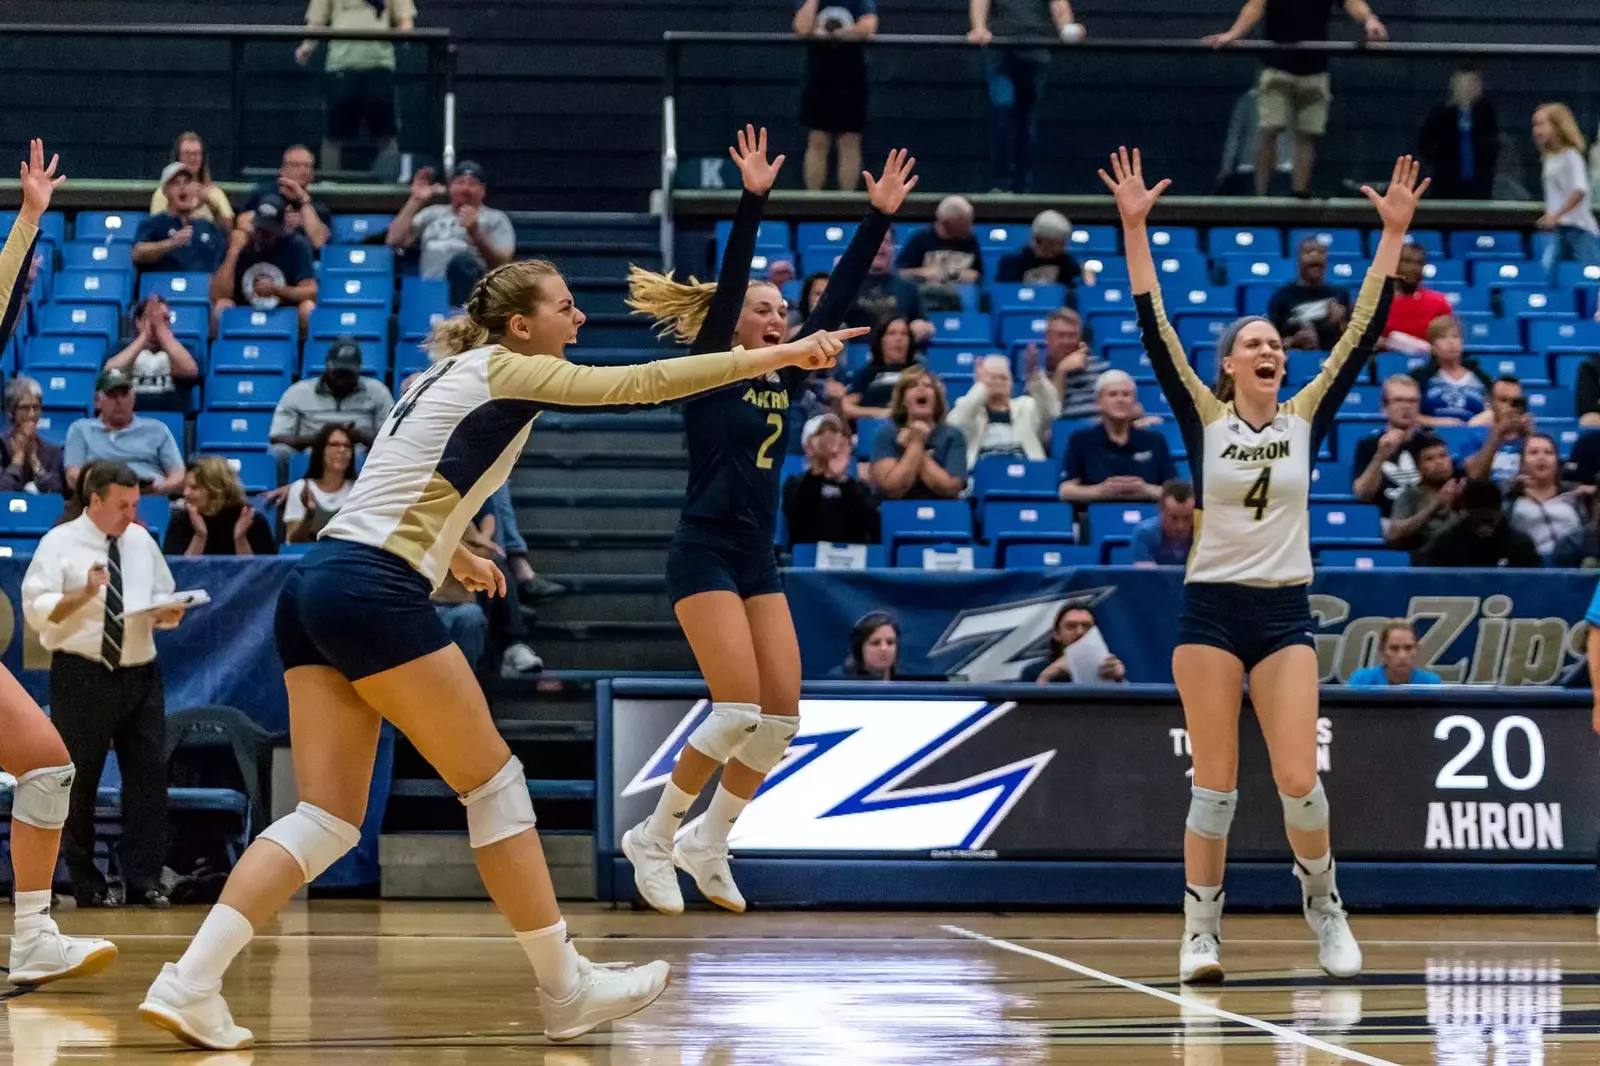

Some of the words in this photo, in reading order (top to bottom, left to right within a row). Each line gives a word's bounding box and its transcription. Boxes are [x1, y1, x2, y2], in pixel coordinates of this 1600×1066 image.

[701, 158, 724, 187] K
[756, 413, 783, 469] 2
[1243, 466, 1272, 521] 4
[1433, 714, 1546, 791] 20
[1423, 800, 1565, 850] AKRON
